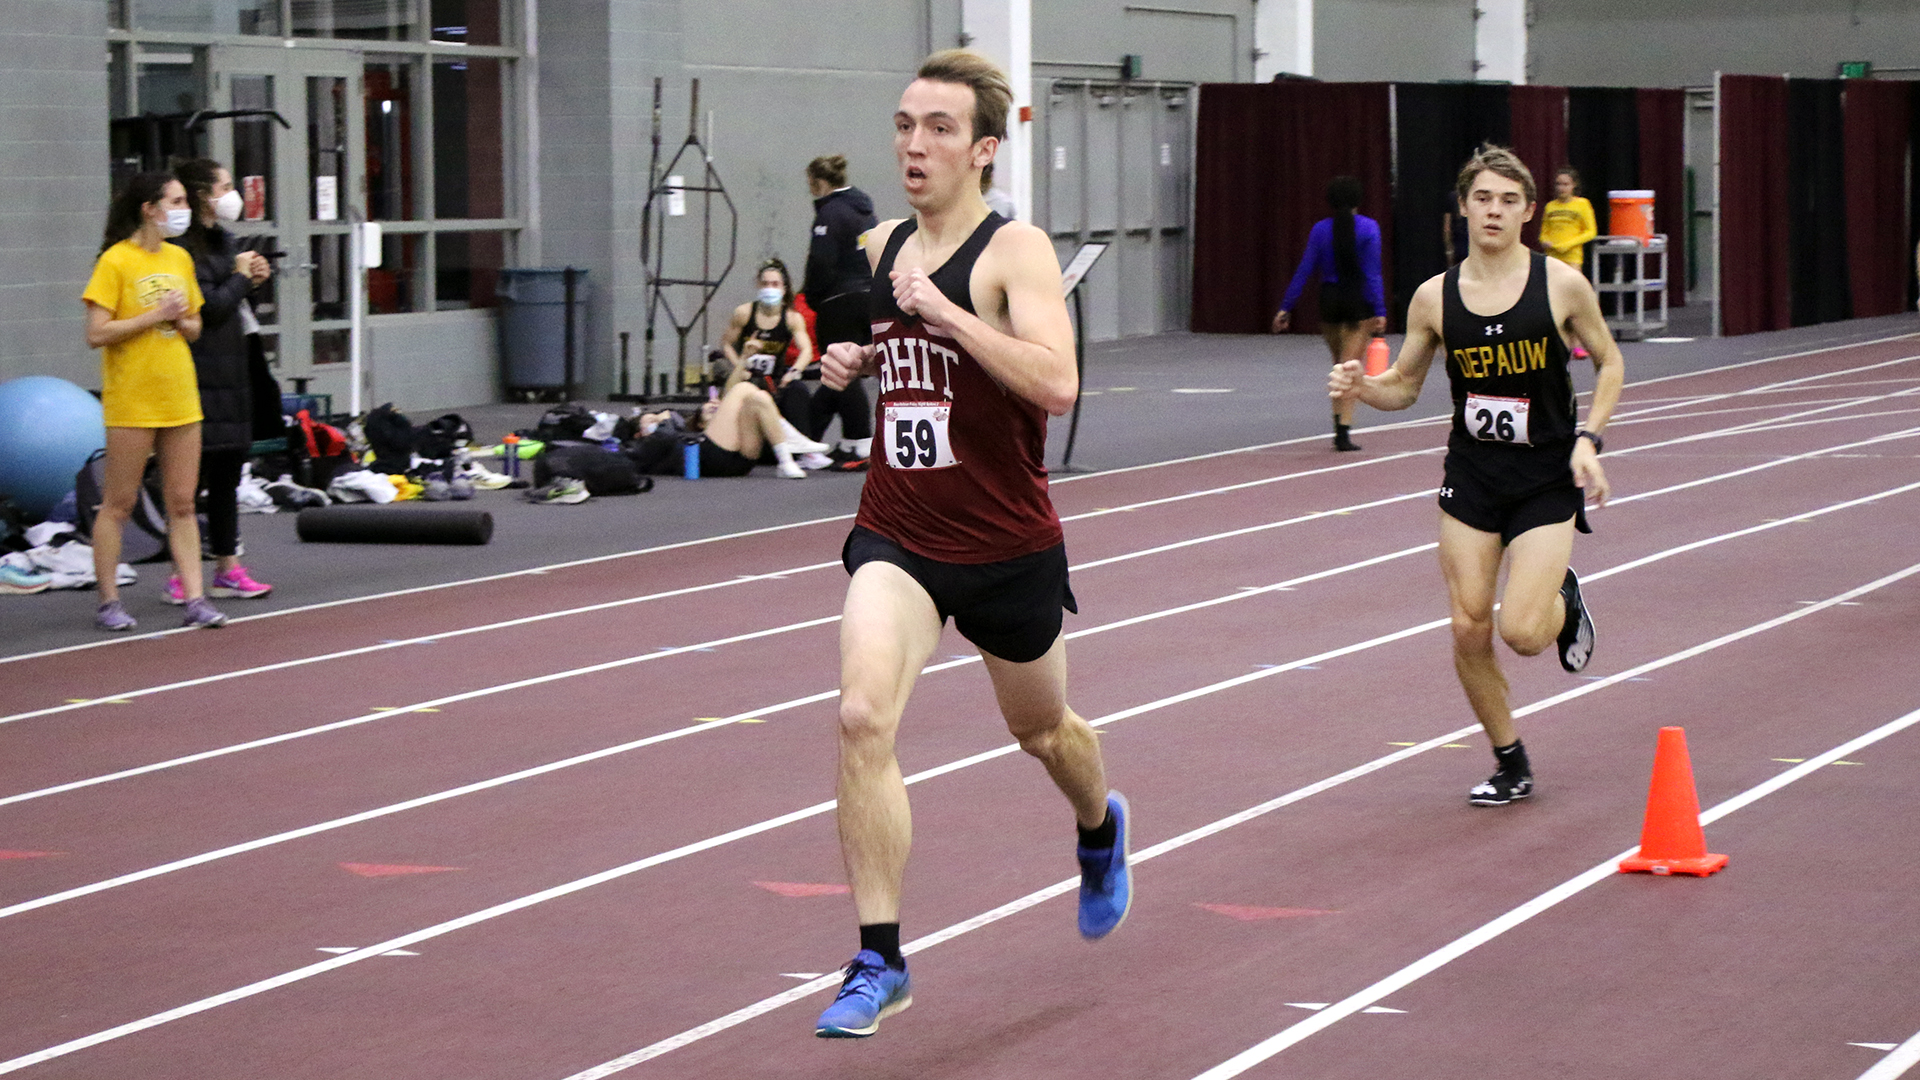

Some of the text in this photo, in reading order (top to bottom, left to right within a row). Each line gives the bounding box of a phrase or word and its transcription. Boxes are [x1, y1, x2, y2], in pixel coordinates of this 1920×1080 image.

[1453, 336, 1548, 378] DEPAUW
[896, 419, 937, 468] 59
[1476, 408, 1515, 441] 26
